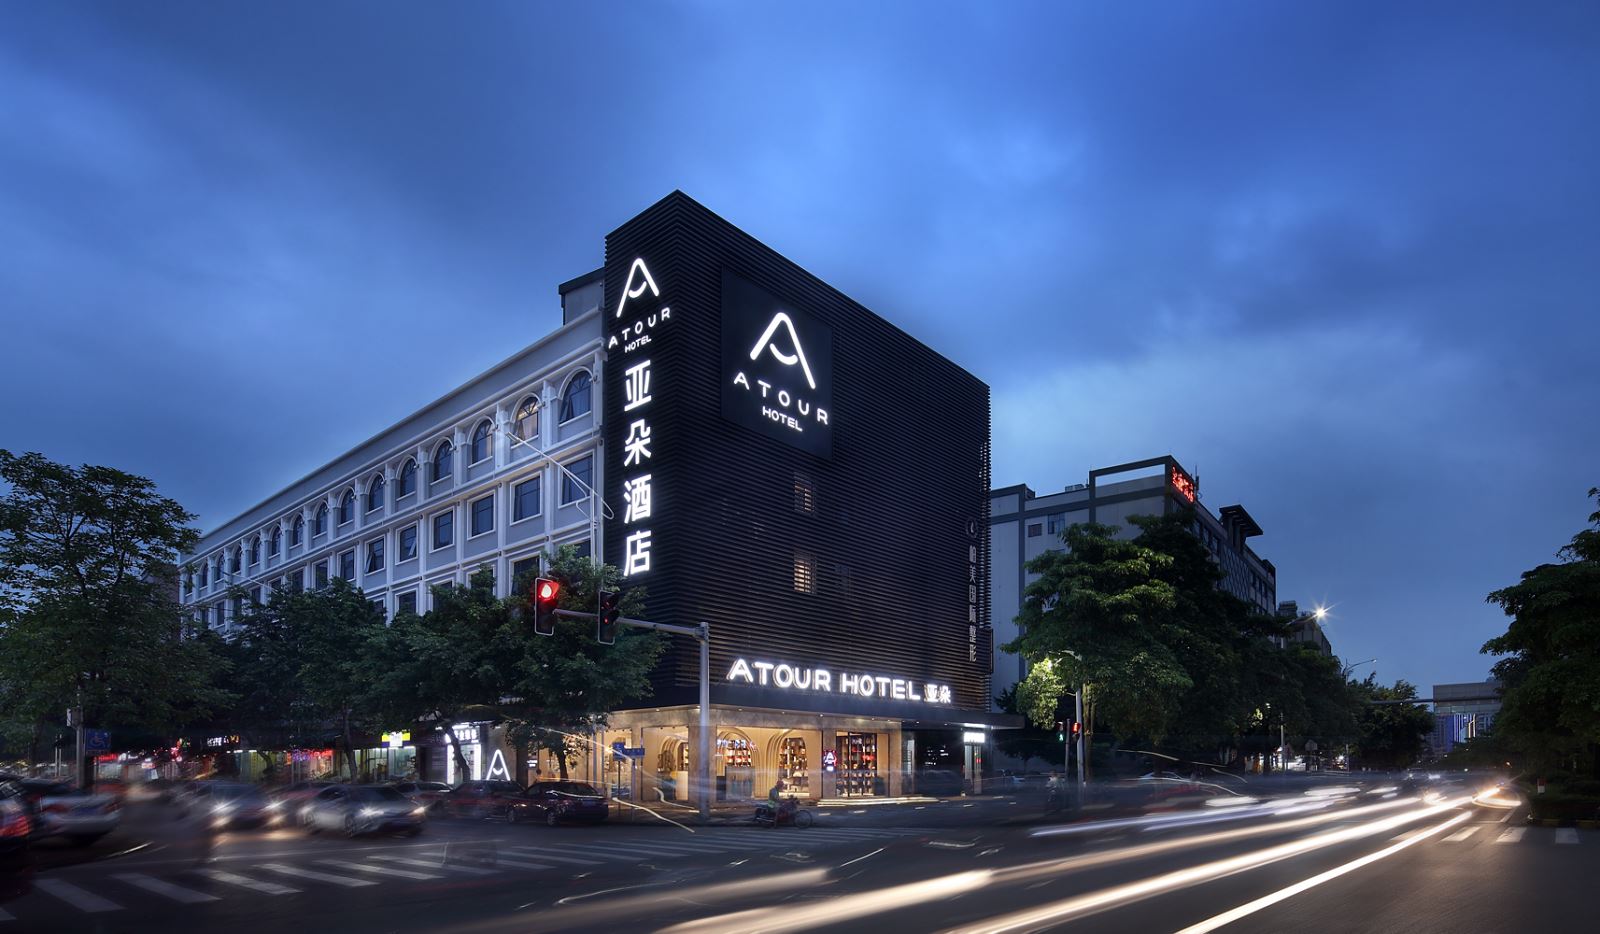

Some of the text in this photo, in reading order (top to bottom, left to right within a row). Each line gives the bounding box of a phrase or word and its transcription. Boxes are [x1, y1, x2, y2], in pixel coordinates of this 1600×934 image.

[608, 307, 671, 349] ATOUR
[624, 335, 652, 353] HOTEL
[733, 371, 829, 425] ATOUR
[762, 405, 803, 432] HOTEL
[623, 359, 652, 577] 亚朵酒店
[726, 657, 952, 704] ATOUR HOTEL 亚朵
